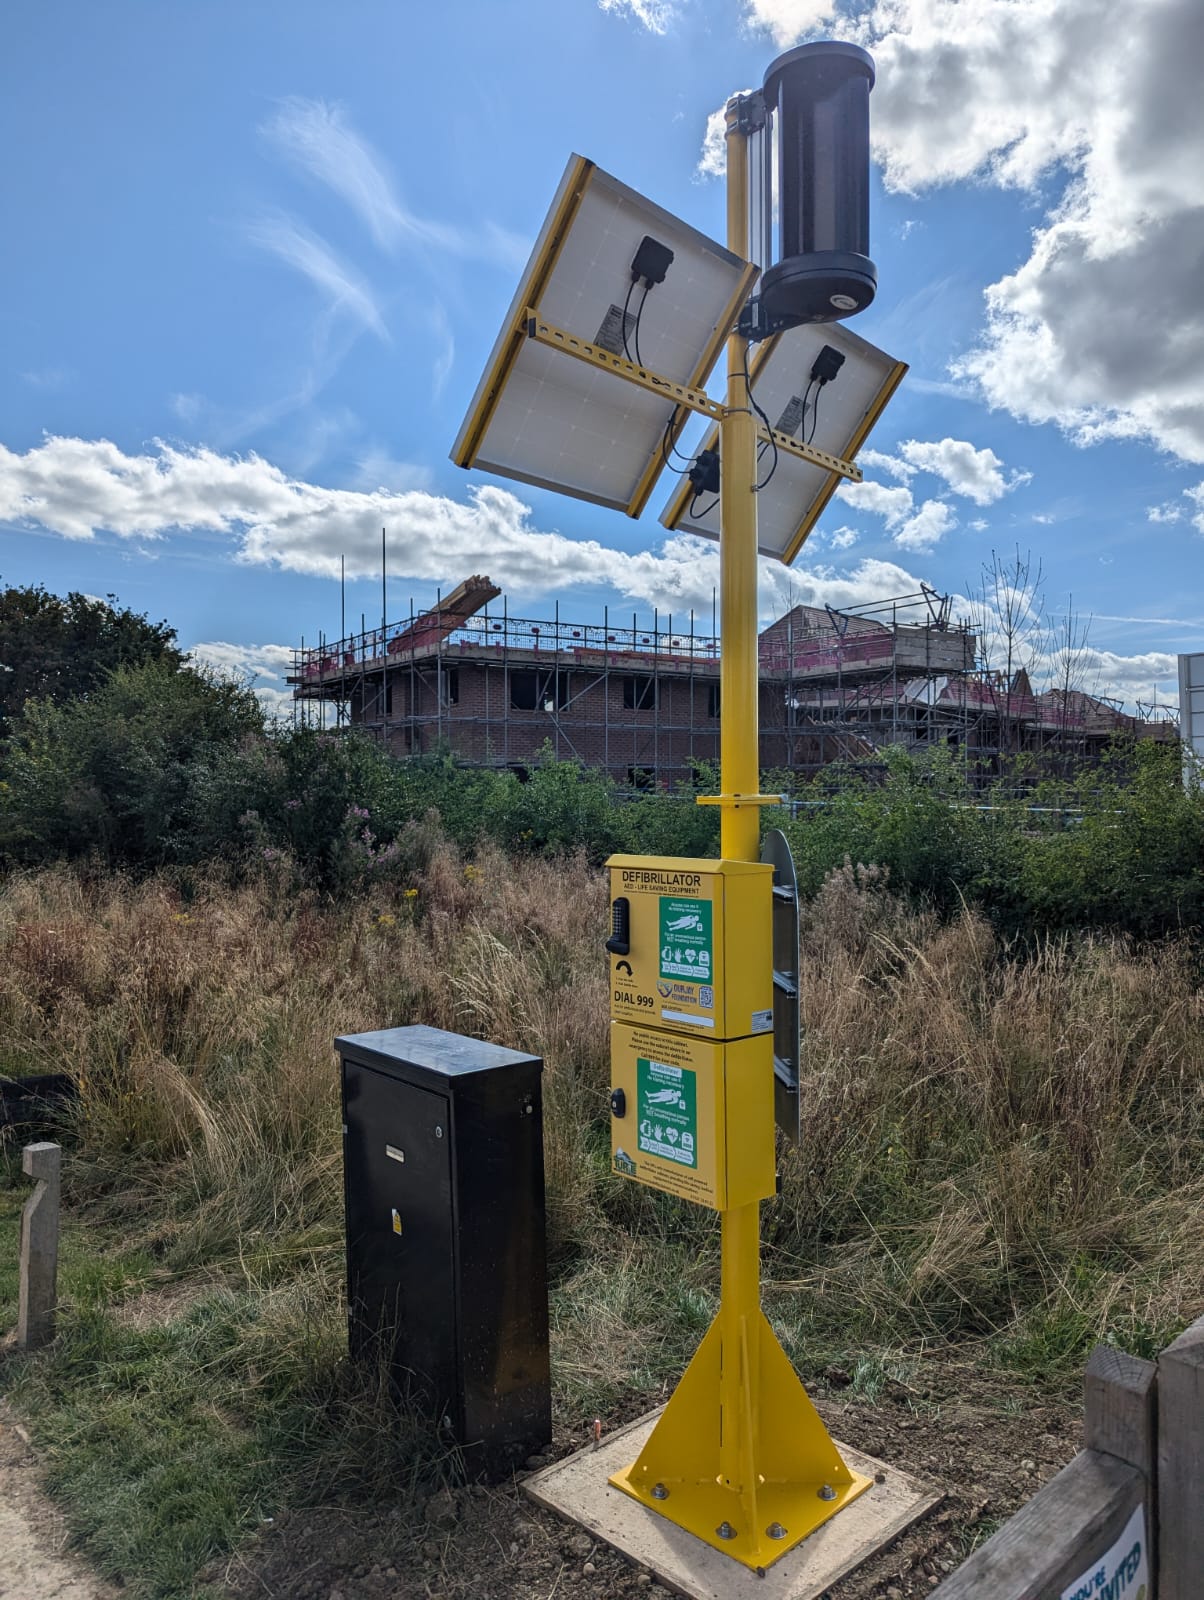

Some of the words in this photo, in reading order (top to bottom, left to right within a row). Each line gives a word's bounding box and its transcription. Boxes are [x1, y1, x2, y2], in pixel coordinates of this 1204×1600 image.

[622, 871, 701, 886] DEFIBRILLATOR
[649, 885, 668, 893] SAVING
[668, 886, 699, 895] EQUIPMENT
[614, 990, 635, 1005] DIAL
[637, 994, 654, 1008] 999
[1095, 1541, 1141, 1600] VITED
